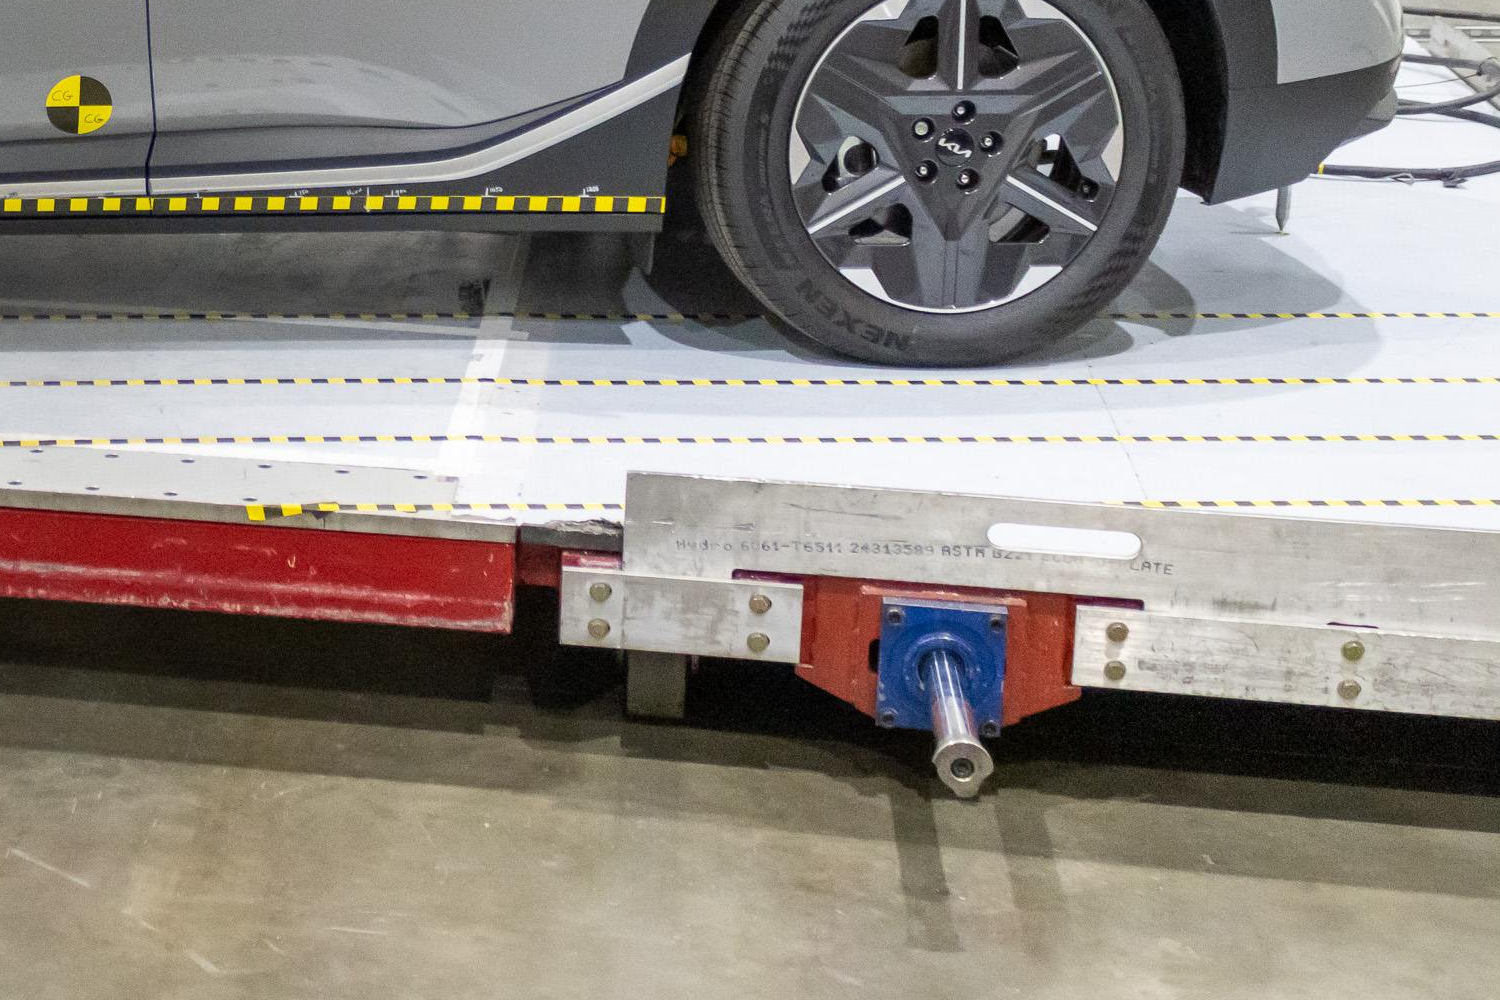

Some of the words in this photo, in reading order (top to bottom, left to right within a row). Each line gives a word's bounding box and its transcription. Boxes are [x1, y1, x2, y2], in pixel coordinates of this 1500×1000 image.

[51, 90, 74, 102] CG
[84, 113, 104, 124] CG
[796, 278, 912, 350] NEXEN
[849, 540, 934, 557] 24313589
[941, 545, 986, 559] ASTM
